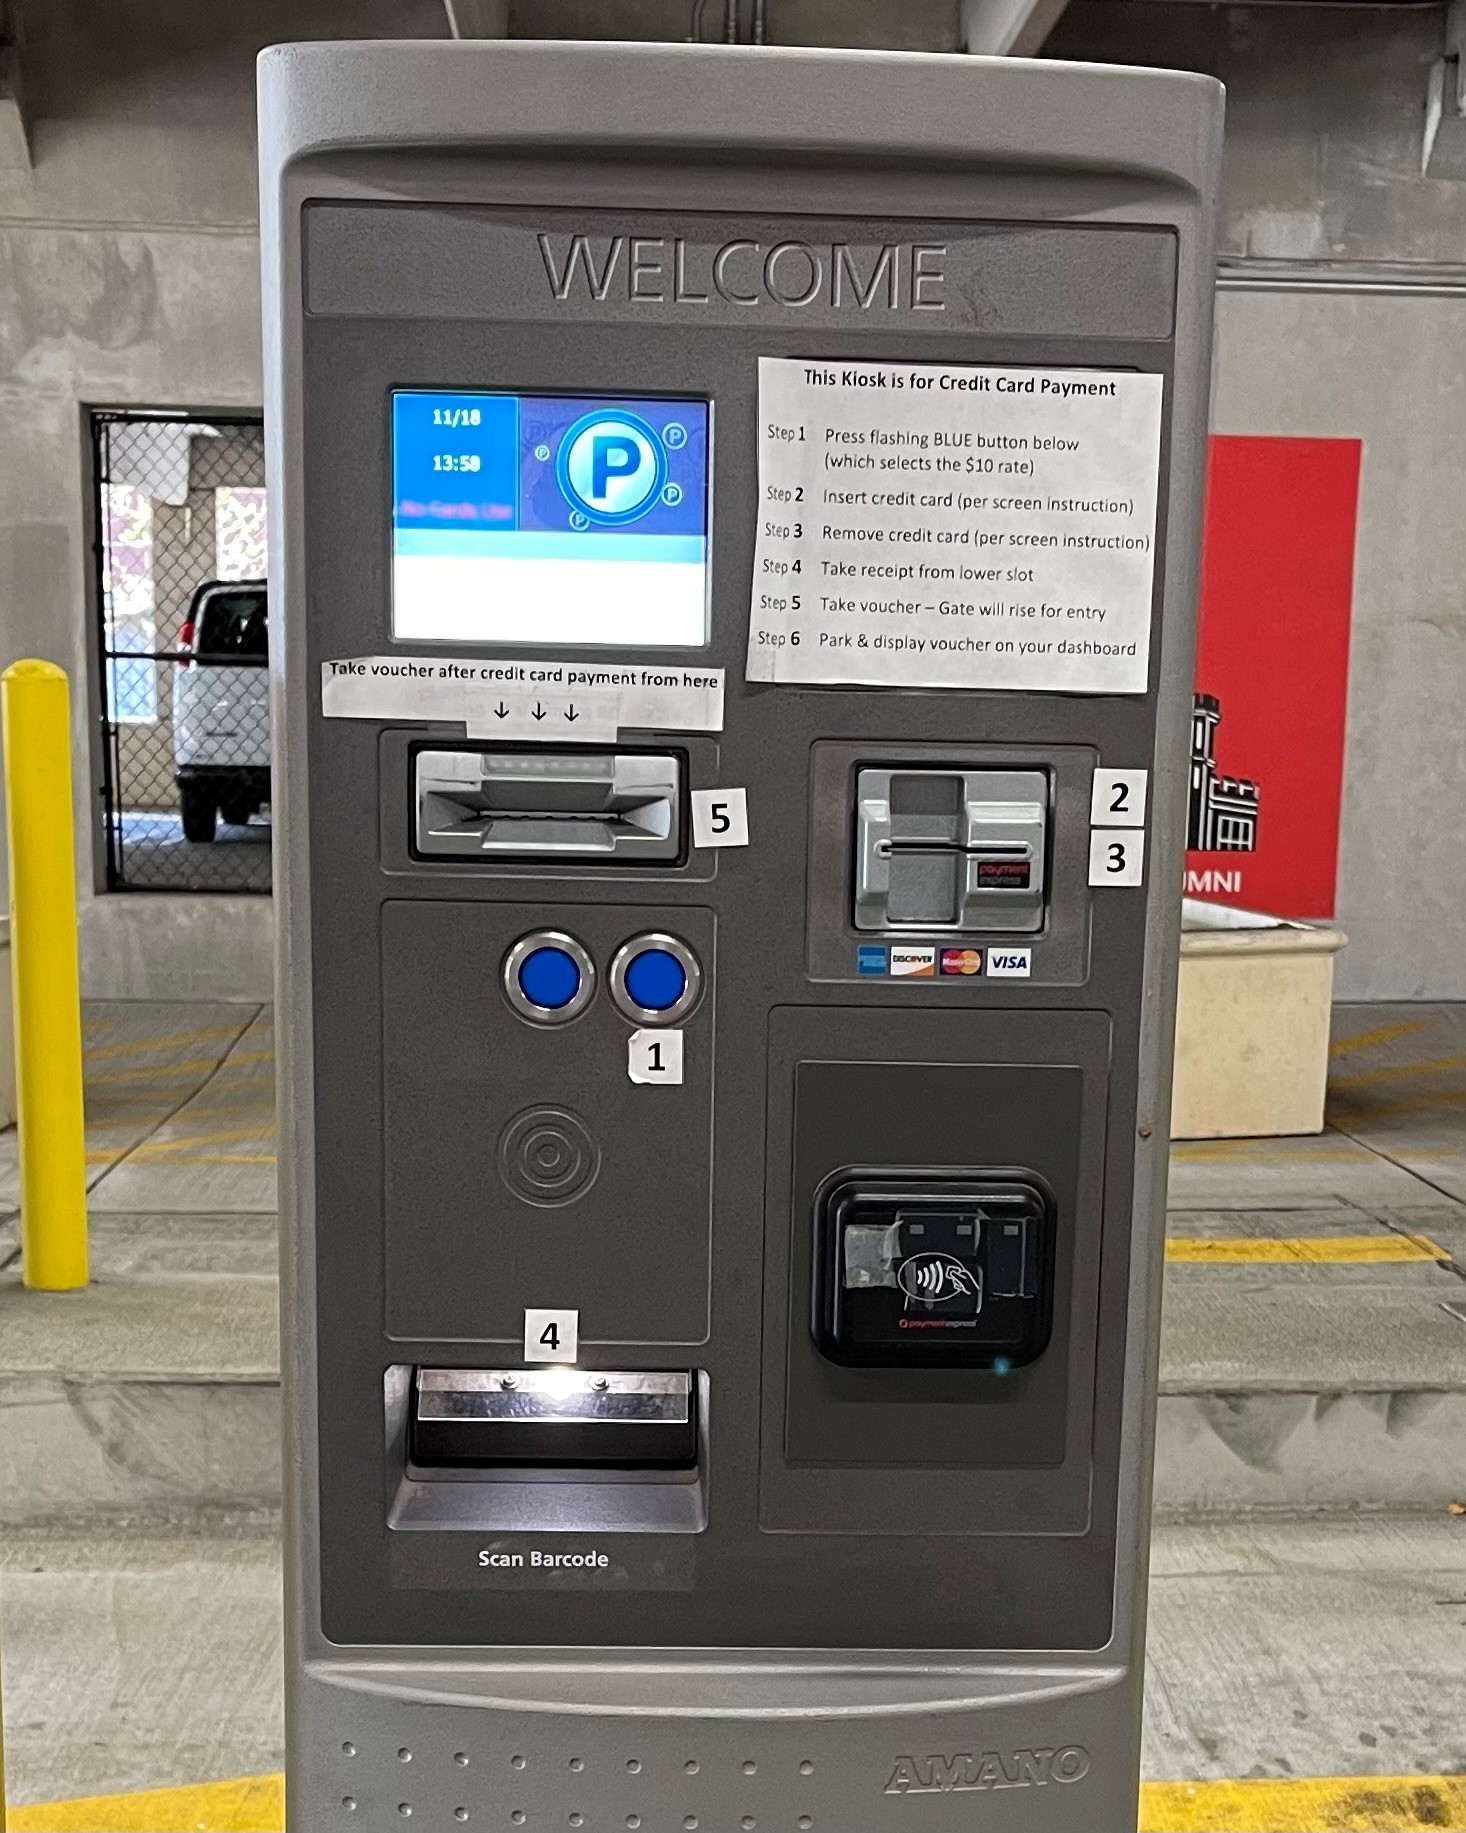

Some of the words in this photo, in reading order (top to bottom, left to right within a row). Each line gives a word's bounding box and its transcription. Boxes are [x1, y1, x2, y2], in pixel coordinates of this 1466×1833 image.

[537, 234, 946, 310] WELCOME
[804, 369, 836, 385] This
[842, 371, 886, 387] Kiosk
[892, 373, 903, 388] is
[910, 373, 934, 389] for
[940, 375, 990, 391] Credit
[996, 377, 1034, 393] Card
[1041, 379, 1115, 398] Payment
[768, 425, 794, 442] Step
[799, 426, 805, 441] 1
[826, 429, 865, 444] Press
[870, 430, 928, 449] flashing
[934, 433, 971, 447] BLUE
[978, 434, 1027, 449] button
[1034, 436, 1079, 450] below
[592, 435, 641, 499] P
[825, 452, 874, 470] (which
[880, 455, 931, 470] selects
[937, 457, 961, 471] the
[966, 457, 993, 473] $10
[999, 460, 1033, 477] rate)
[768, 486, 791, 501] Step
[795, 487, 803, 502] 2
[824, 490, 866, 504] Insert
[872, 492, 915, 506] credit
[921, 493, 952, 506] card
[958, 493, 988, 510] (per
[993, 499, 1041, 509] screen
[1048, 497, 1133, 516] instruction)
[766, 523, 789, 538] Step
[794, 523, 802, 538] 3
[823, 526, 883, 541] Remove
[889, 528, 932, 542] credit
[937, 530, 969, 543] card
[975, 530, 1004, 547] (per
[1010, 535, 1057, 546] screen
[1064, 536, 1149, 552] instruction)
[763, 559, 788, 576] Step
[792, 560, 801, 574] 4
[821, 561, 856, 576] Take
[862, 566, 913, 580] receipt
[919, 564, 954, 578] from
[960, 566, 1001, 580] lower
[1007, 568, 1033, 581] slot
[761, 595, 786, 612] Step
[792, 596, 800, 610] 5
[821, 598, 855, 611] Take
[860, 600, 921, 614] voucher
[939, 601, 974, 615] Gate
[980, 603, 1003, 616] will
[1010, 606, 1035, 617] rise
[1041, 604, 1062, 617] for
[1067, 608, 1106, 622] entry
[758, 631, 785, 648] Step
[791, 631, 800, 645] 6
[820, 633, 852, 647] Park
[858, 634, 868, 647] &
[874, 635, 925, 652] display
[930, 637, 990, 651] voucher
[996, 642, 1013, 652] on
[1019, 643, 1052, 655] your
[1058, 640, 1136, 655] dashboard
[327, 659, 366, 676] Take
[371, 663, 434, 677] voucher
[439, 664, 476, 678] after
[481, 667, 525, 680] credit
[530, 668, 562, 681] card
[568, 673, 636, 686] payment
[642, 672, 678, 686] from
[684, 673, 717, 688] here
[1110, 783, 1128, 812] 2
[712, 803, 730, 833] 5
[1107, 843, 1125, 872] 3
[1183, 870, 1241, 892] MNI
[992, 956, 1027, 968] VISA
[648, 1043, 665, 1071] 1
[540, 1323, 560, 1350] 4
[479, 1551, 523, 1567] Scan
[531, 1551, 609, 1567] Barcode
[884, 1745, 1090, 1794] AMANO
